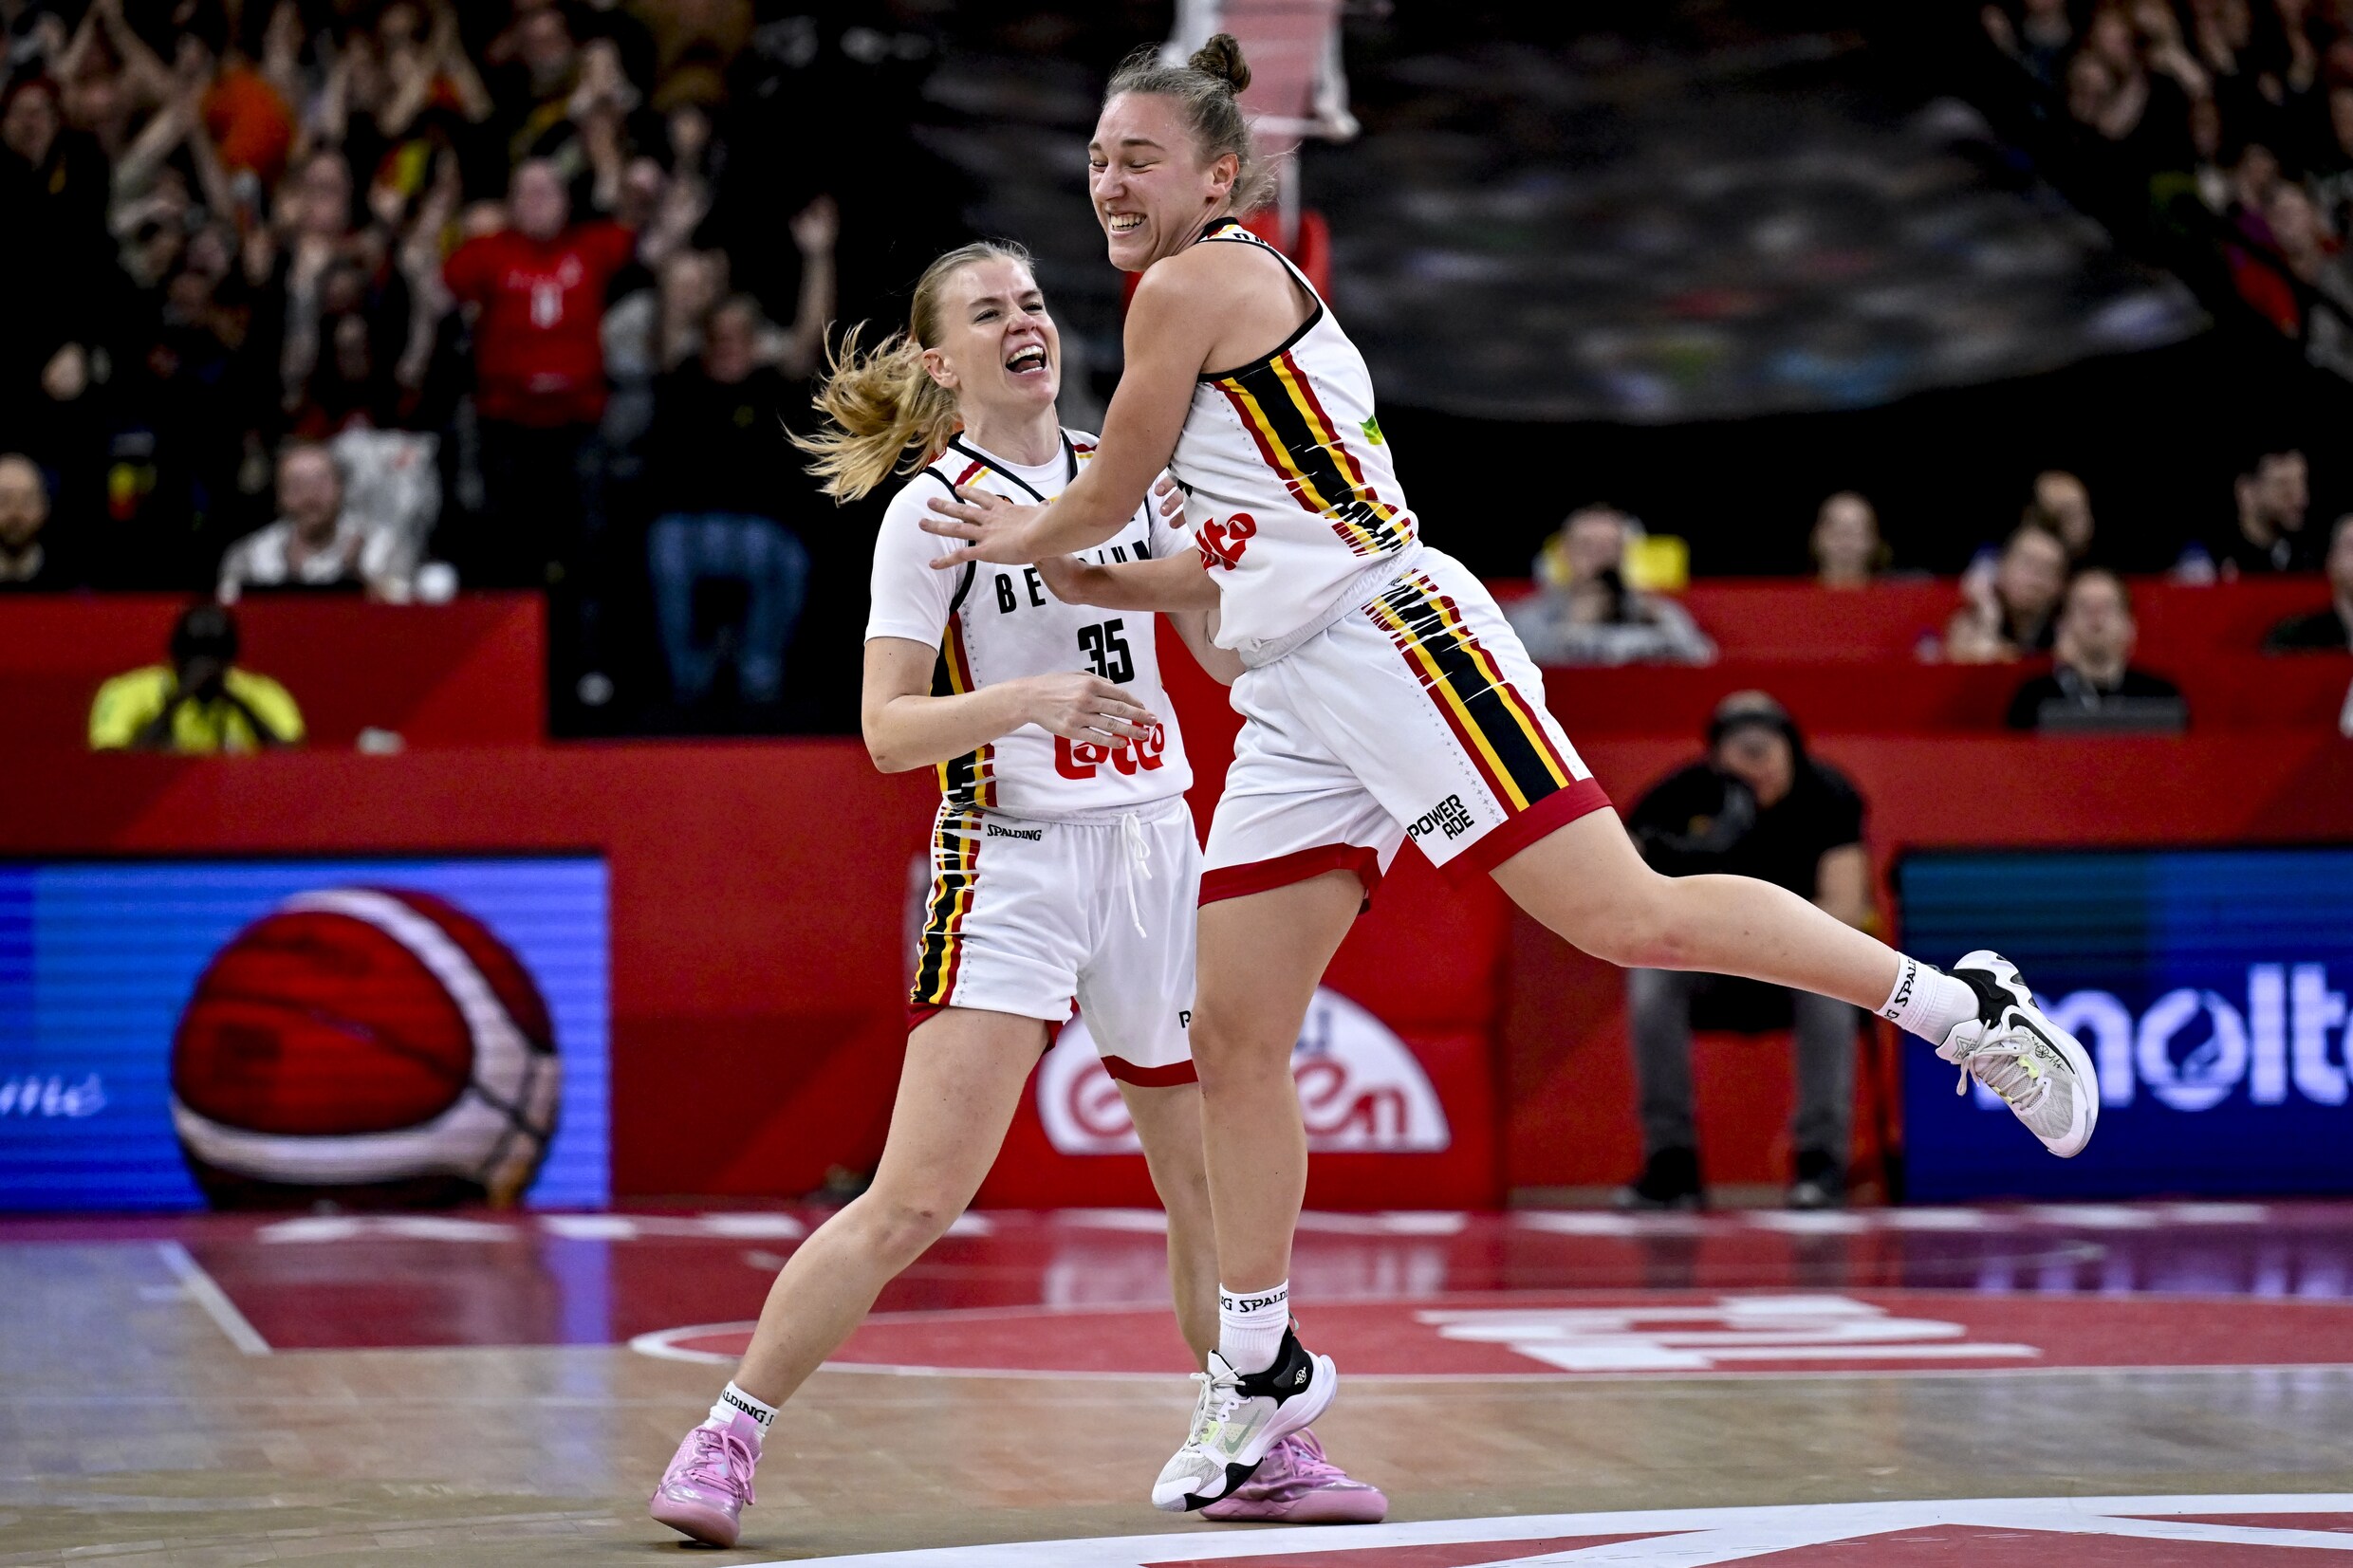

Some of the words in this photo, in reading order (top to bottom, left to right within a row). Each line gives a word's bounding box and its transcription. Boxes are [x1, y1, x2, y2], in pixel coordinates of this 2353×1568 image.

[1077, 618, 1135, 685] 35
[987, 823, 1043, 841] SPALDING
[1406, 794, 1466, 842] POWER
[1441, 808, 1475, 840] ADE
